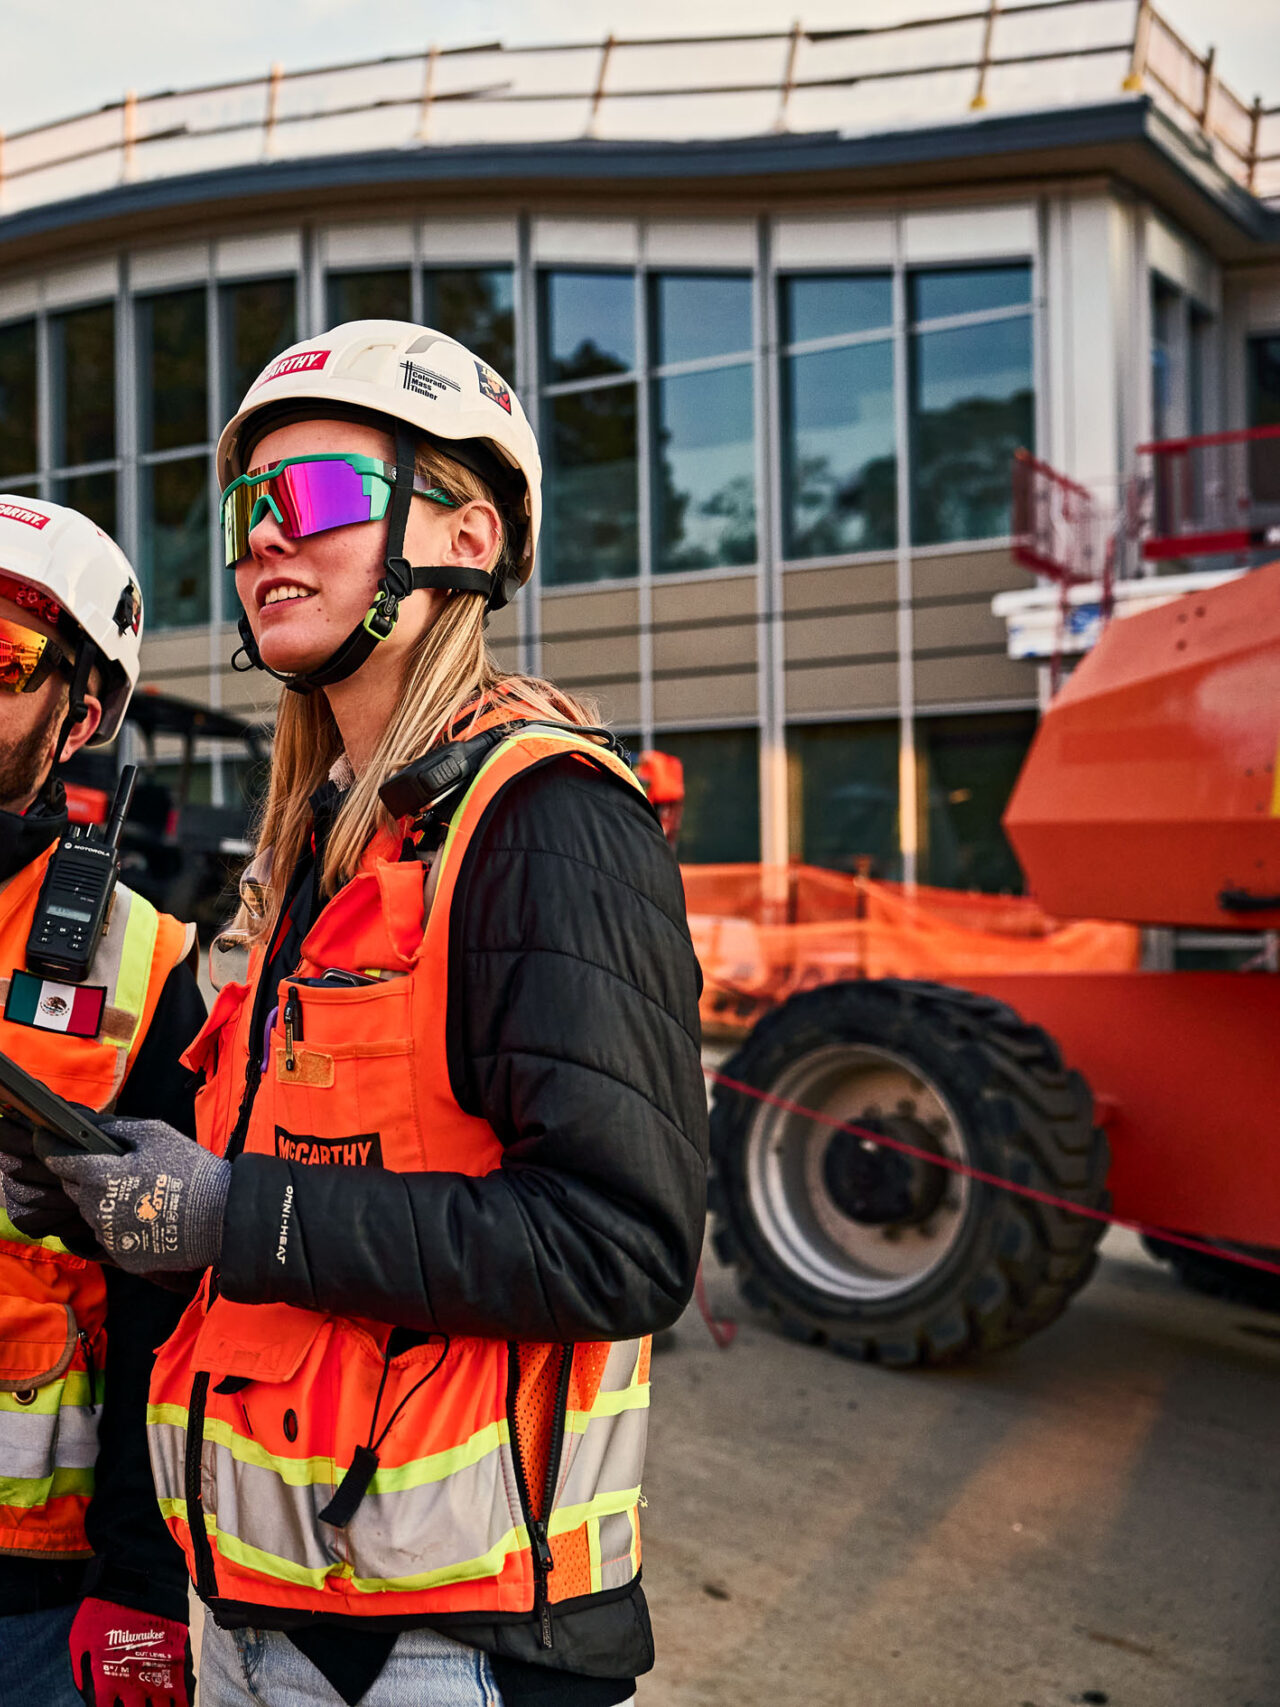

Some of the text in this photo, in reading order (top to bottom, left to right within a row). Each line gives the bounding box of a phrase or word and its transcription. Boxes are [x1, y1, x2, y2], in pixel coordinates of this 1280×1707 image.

[411, 378, 432, 391] Mass
[412, 371, 447, 391] Colorado
[410, 385, 438, 401] Timber
[74, 844, 111, 857] MOTOROLA
[276, 1185, 294, 1264] OMNI-HEAT
[104, 1629, 165, 1645] Milwaukee
